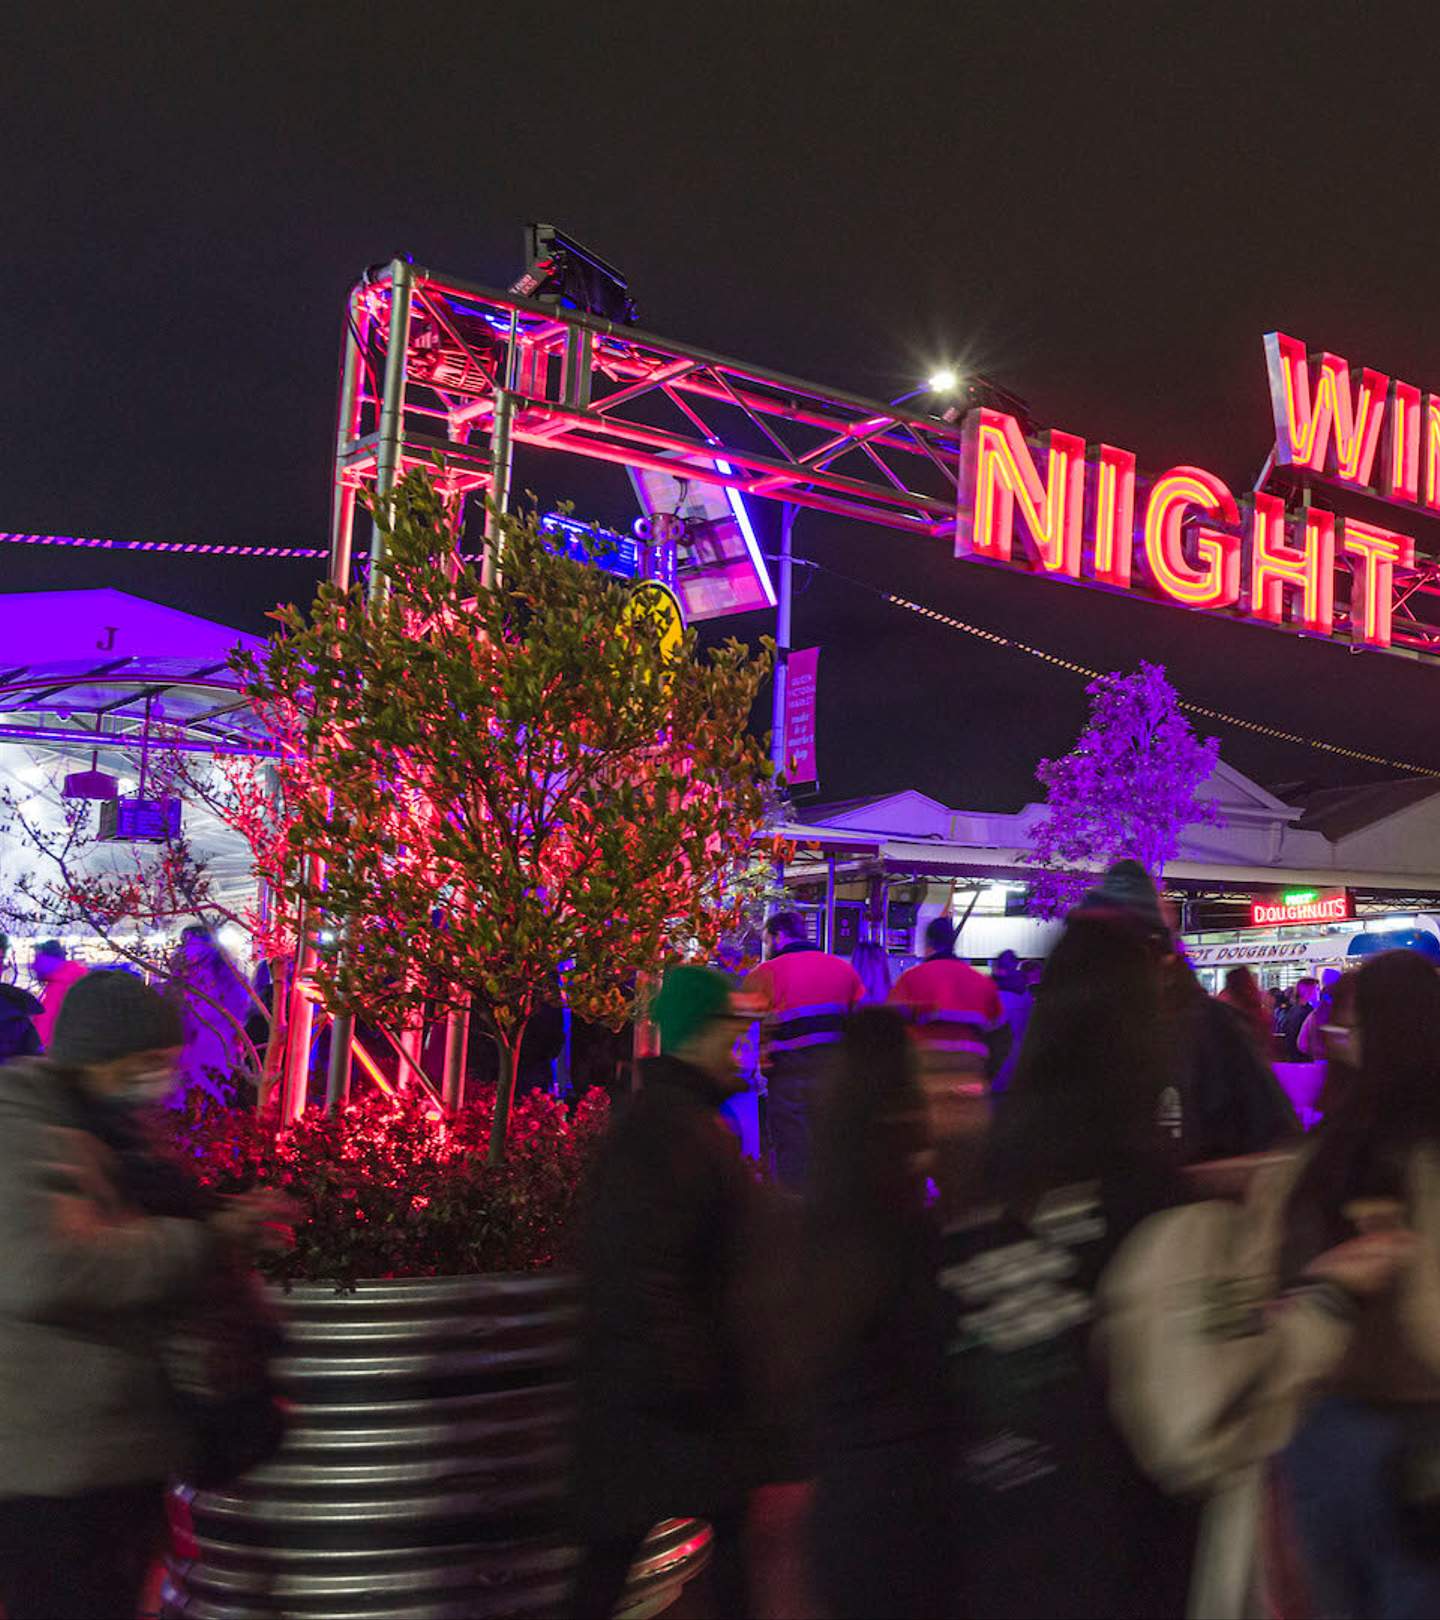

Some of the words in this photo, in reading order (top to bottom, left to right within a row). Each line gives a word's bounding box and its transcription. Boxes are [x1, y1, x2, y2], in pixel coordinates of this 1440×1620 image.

[955, 406, 1415, 648] NIGHT
[96, 626, 119, 651] J
[1254, 897, 1346, 924] DOUGHNUTS
[1216, 941, 1309, 961] DOUGHNUTS
